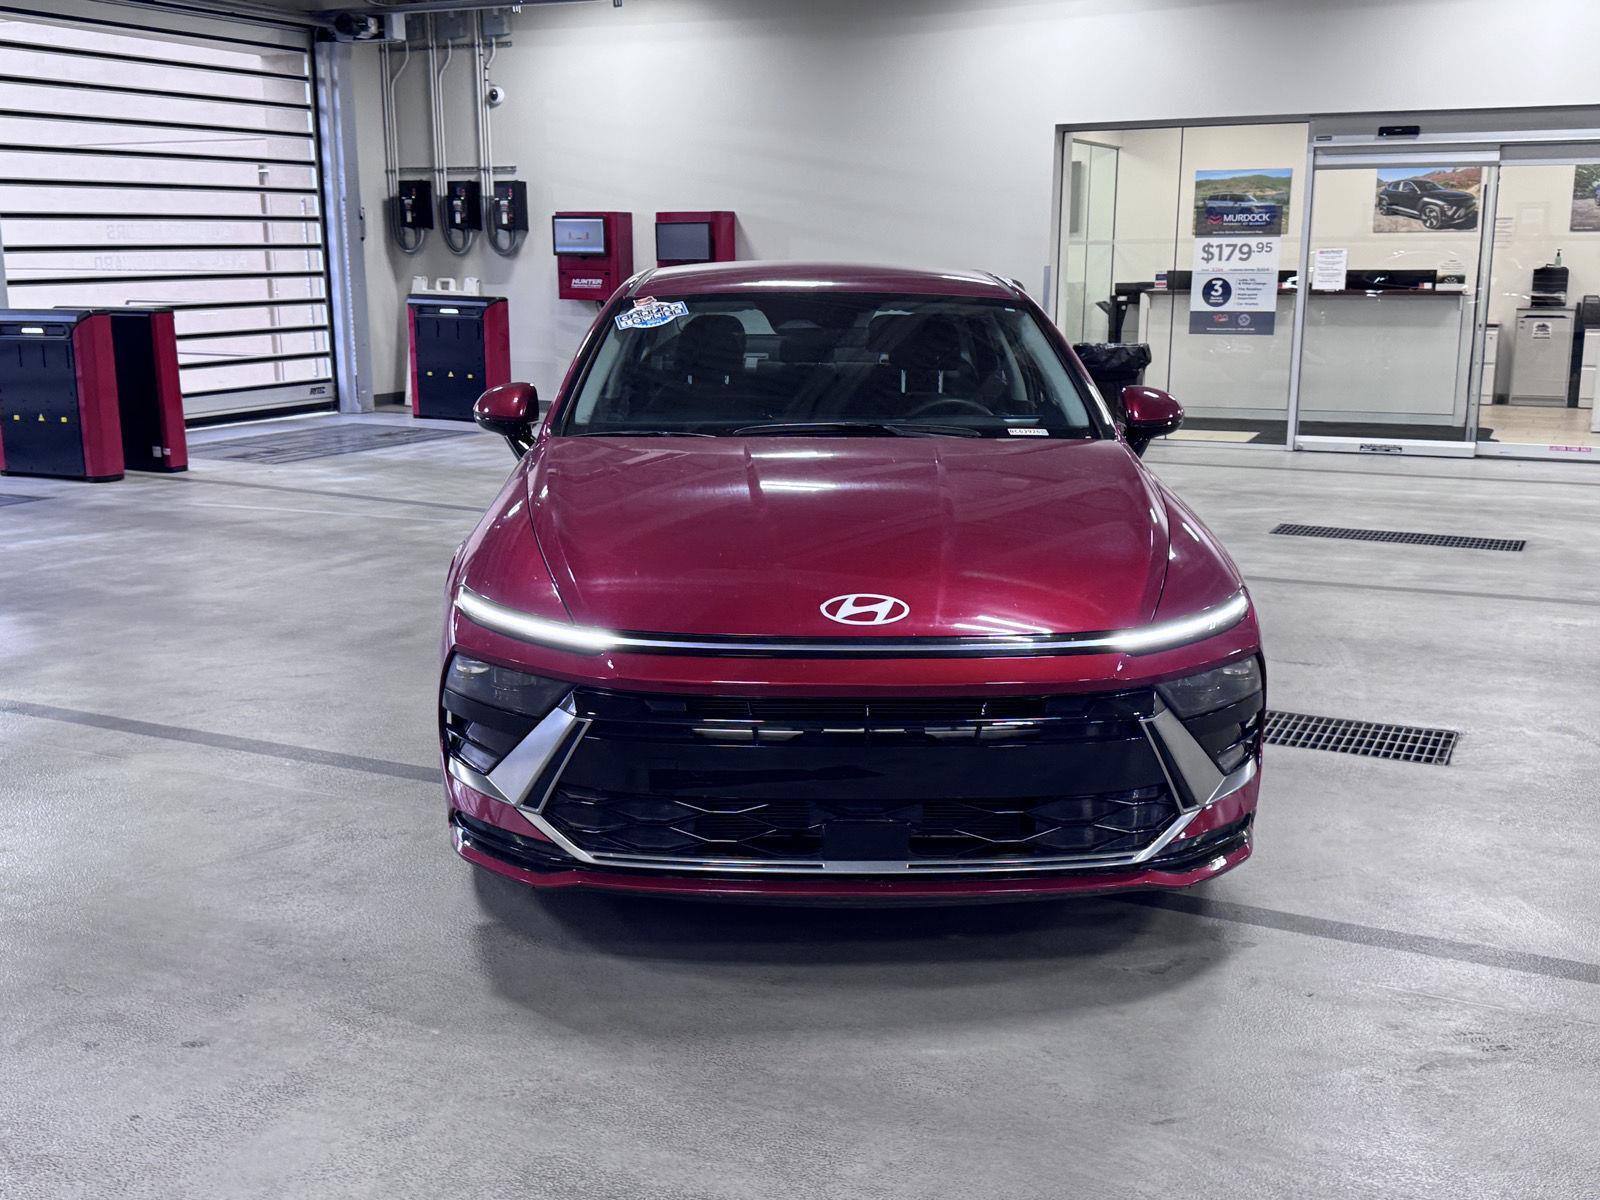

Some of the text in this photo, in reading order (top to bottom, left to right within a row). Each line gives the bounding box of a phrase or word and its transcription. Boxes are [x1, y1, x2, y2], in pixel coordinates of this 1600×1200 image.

[1223, 213, 1271, 222] MURDOCK
[571, 278, 603, 286] HUNTER
[1210, 280, 1223, 296] 3
[620, 304, 681, 321] CARFAX
